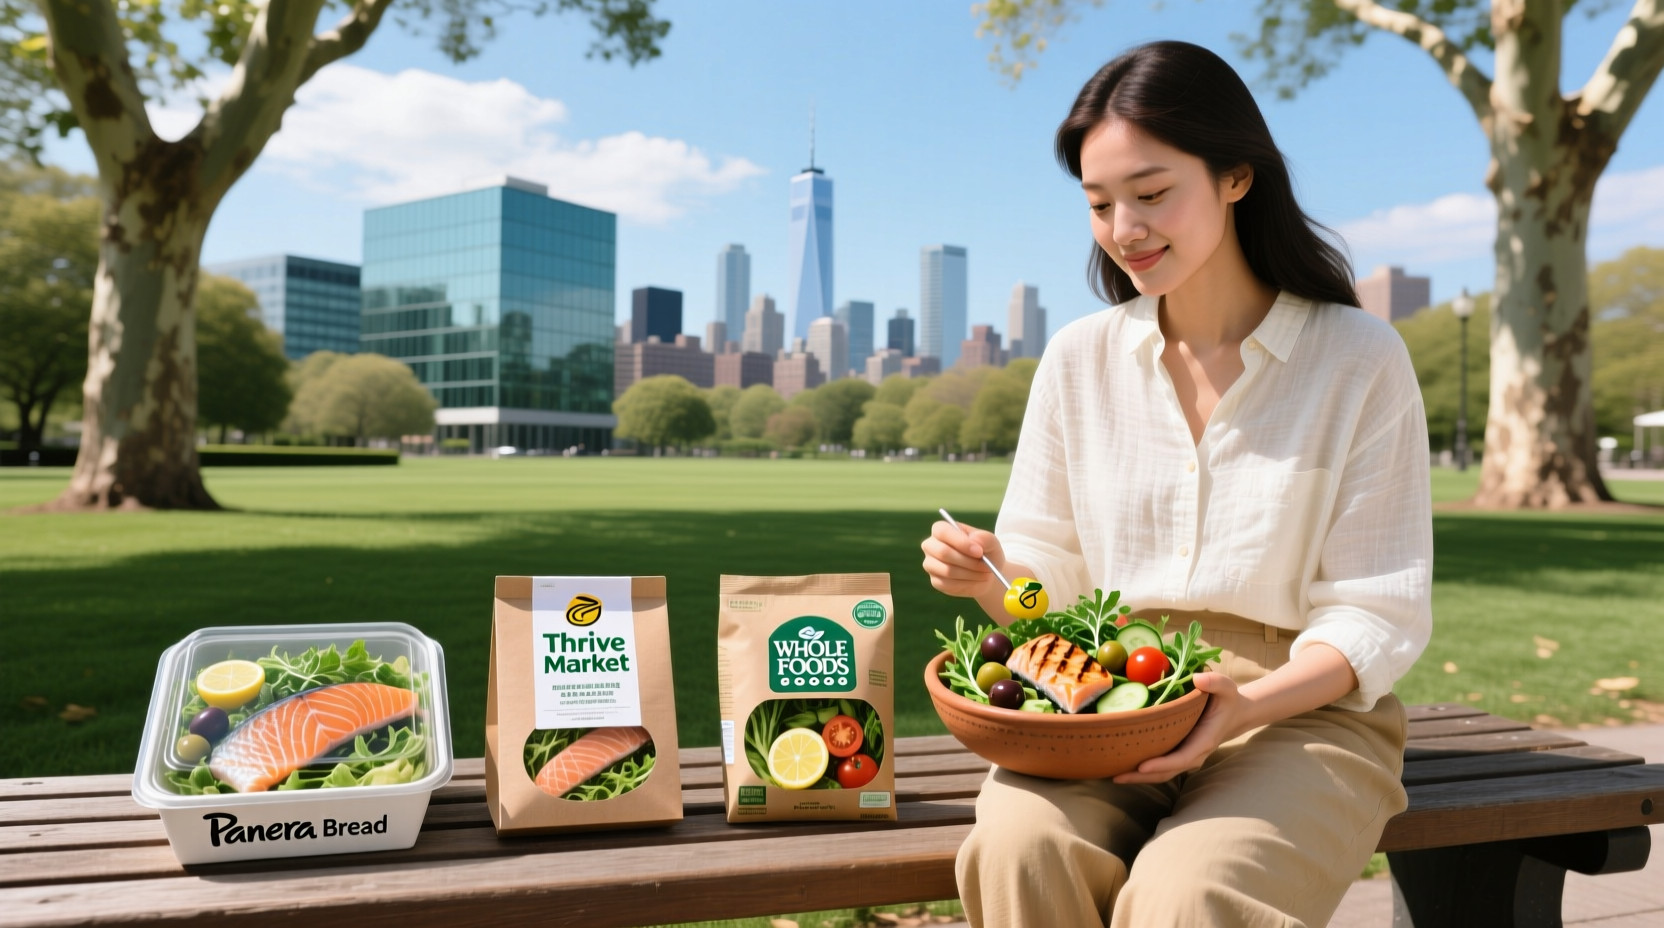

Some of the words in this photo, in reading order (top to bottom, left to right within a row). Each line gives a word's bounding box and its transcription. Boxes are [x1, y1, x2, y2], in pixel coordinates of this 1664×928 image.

[542, 631, 626, 653] Thrive
[773, 639, 849, 658] WHOLE
[544, 653, 630, 674] Market
[777, 657, 850, 676] FOODS
[202, 812, 318, 847] Panera
[322, 814, 388, 838] Bread
